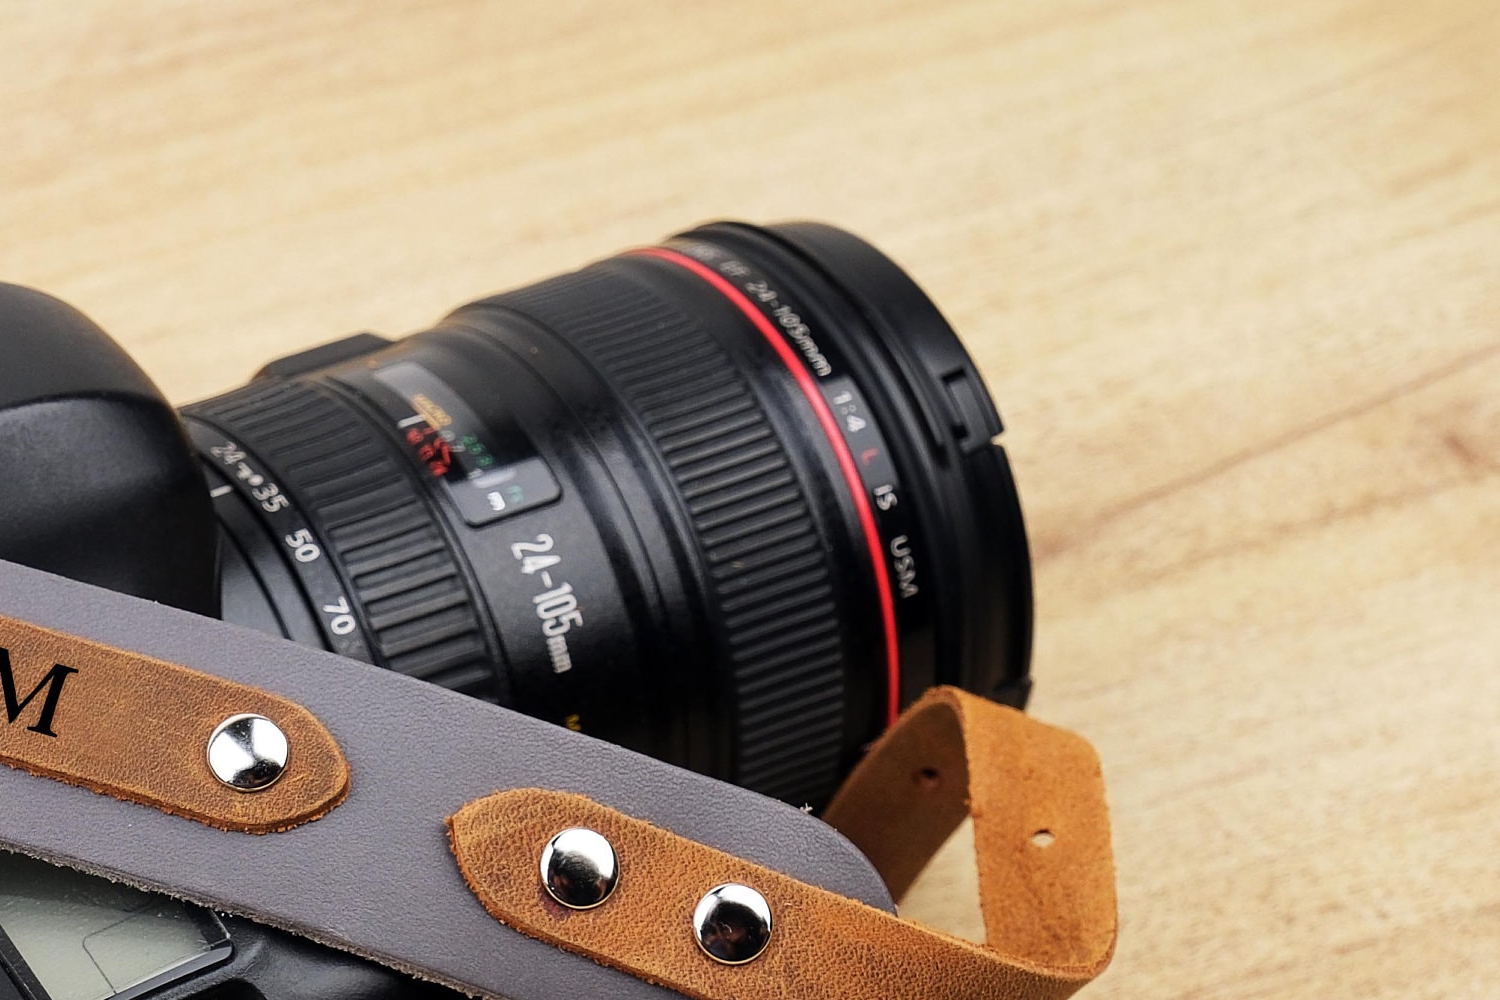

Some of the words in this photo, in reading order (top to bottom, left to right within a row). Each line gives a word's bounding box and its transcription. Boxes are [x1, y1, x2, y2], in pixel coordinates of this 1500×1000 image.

[745, 280, 832, 377] 24-105mm
[834, 390, 867, 432] 1:4
[861, 448, 879, 467] L
[874, 484, 898, 511] IS
[890, 534, 919, 599] USM
[210, 441, 246, 465] 24
[251, 482, 290, 513] 35
[285, 527, 320, 563] 50
[323, 596, 356, 635] 70
[511, 533, 584, 674] 24-105mm
